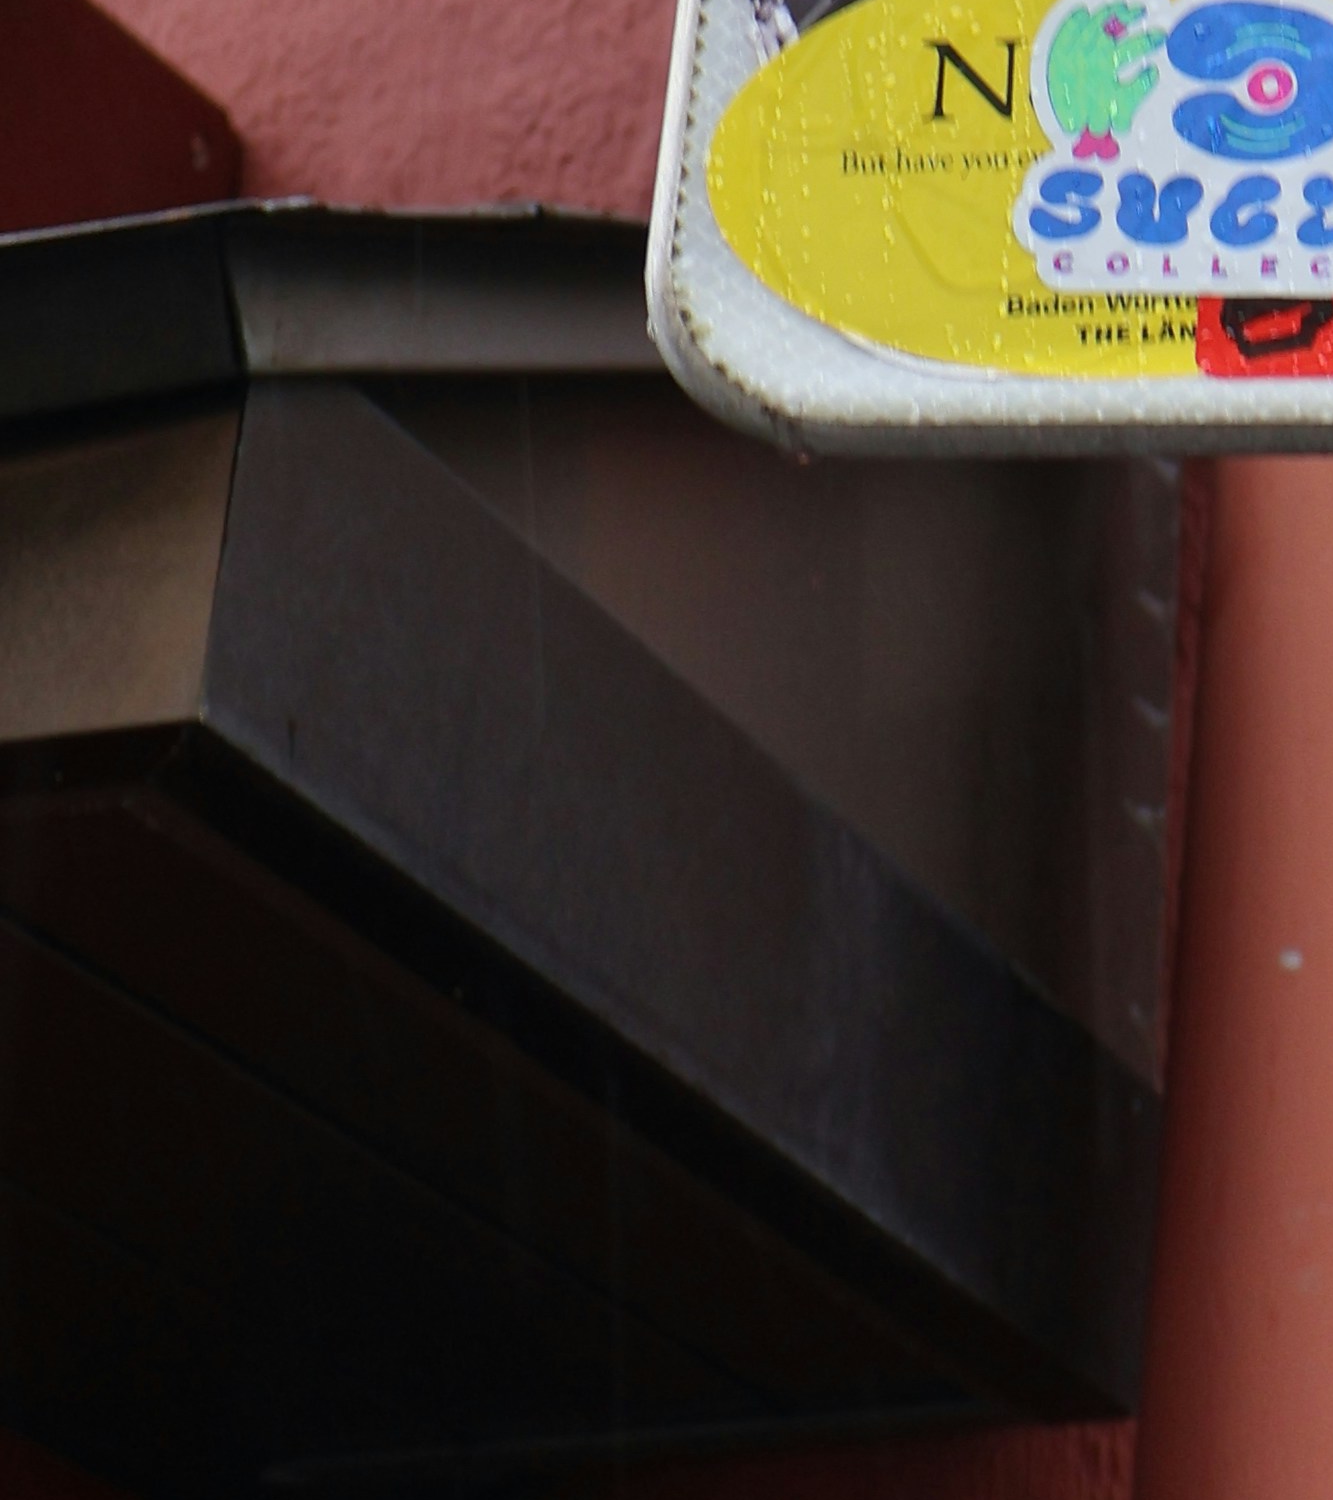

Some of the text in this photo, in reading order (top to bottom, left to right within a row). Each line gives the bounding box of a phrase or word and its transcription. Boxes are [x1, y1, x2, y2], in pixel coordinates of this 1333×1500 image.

[842, 150, 883, 176] But
[897, 148, 952, 174] have
[962, 150, 1009, 182] you
[1076, 323, 1129, 344] THE
